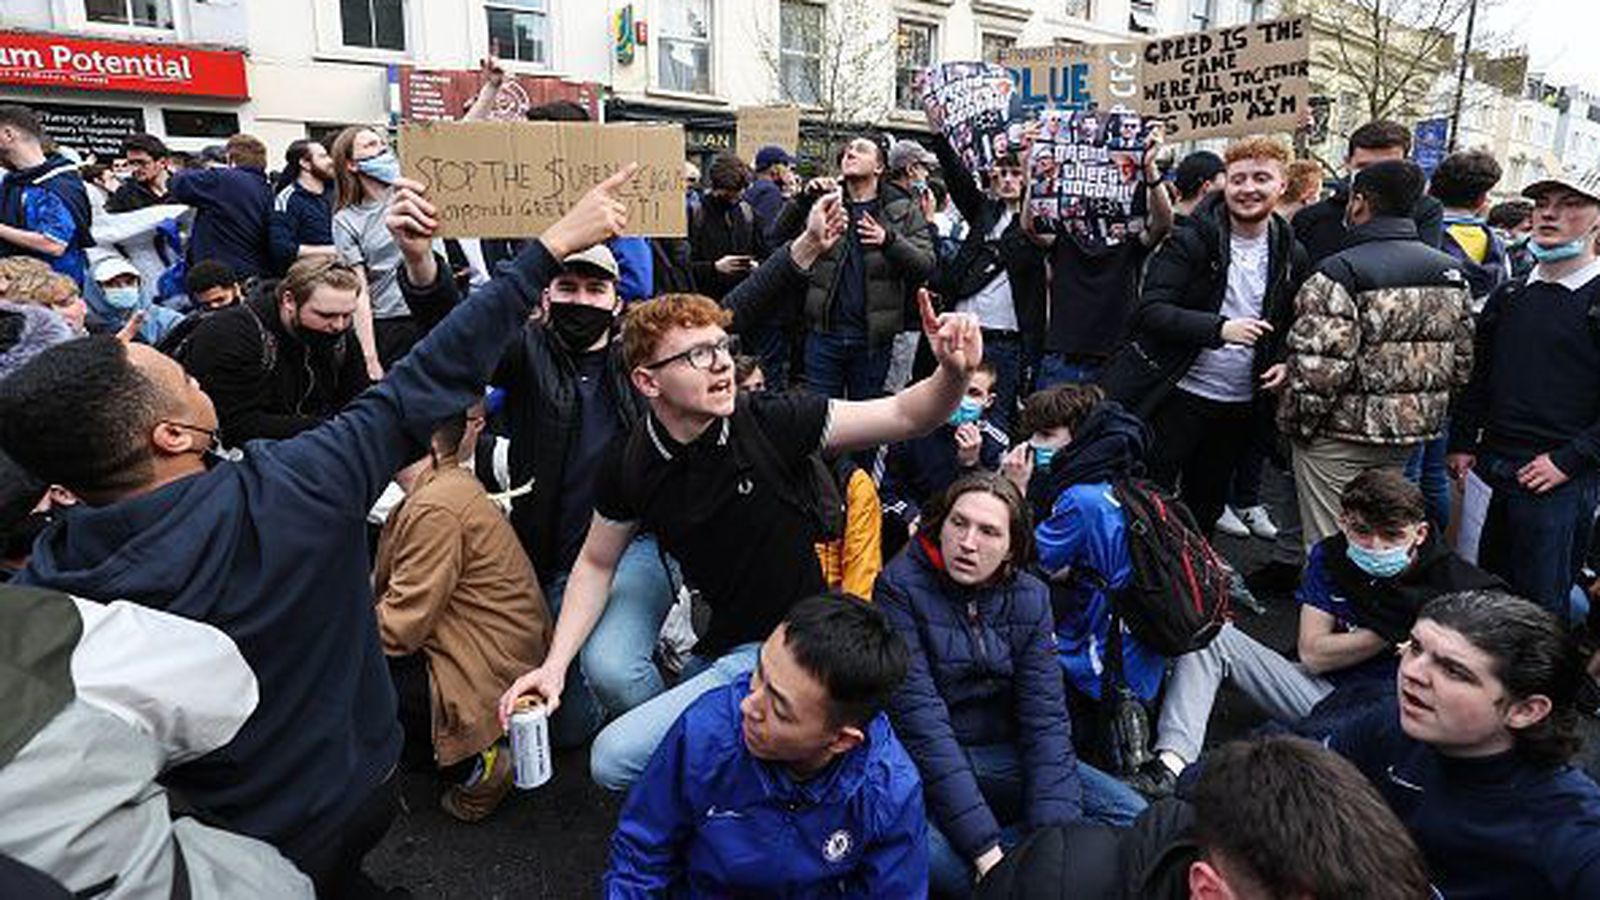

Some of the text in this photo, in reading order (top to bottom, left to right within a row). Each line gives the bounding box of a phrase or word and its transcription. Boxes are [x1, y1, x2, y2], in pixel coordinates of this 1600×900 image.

[1144, 19, 1303, 65] GREED IS THE
[49, 45, 192, 79] Potential
[1109, 50, 1137, 97] CFC
[1181, 53, 1237, 76] GAME
[1143, 59, 1309, 101] WERE ALL TOGETHER
[1159, 83, 1281, 114] BUT MONEY
[1188, 107, 1234, 130] YOUR
[1246, 96, 1296, 121] AIM
[415, 155, 478, 192] STOP
[480, 160, 531, 191] THE
[440, 195, 513, 230] orporate
